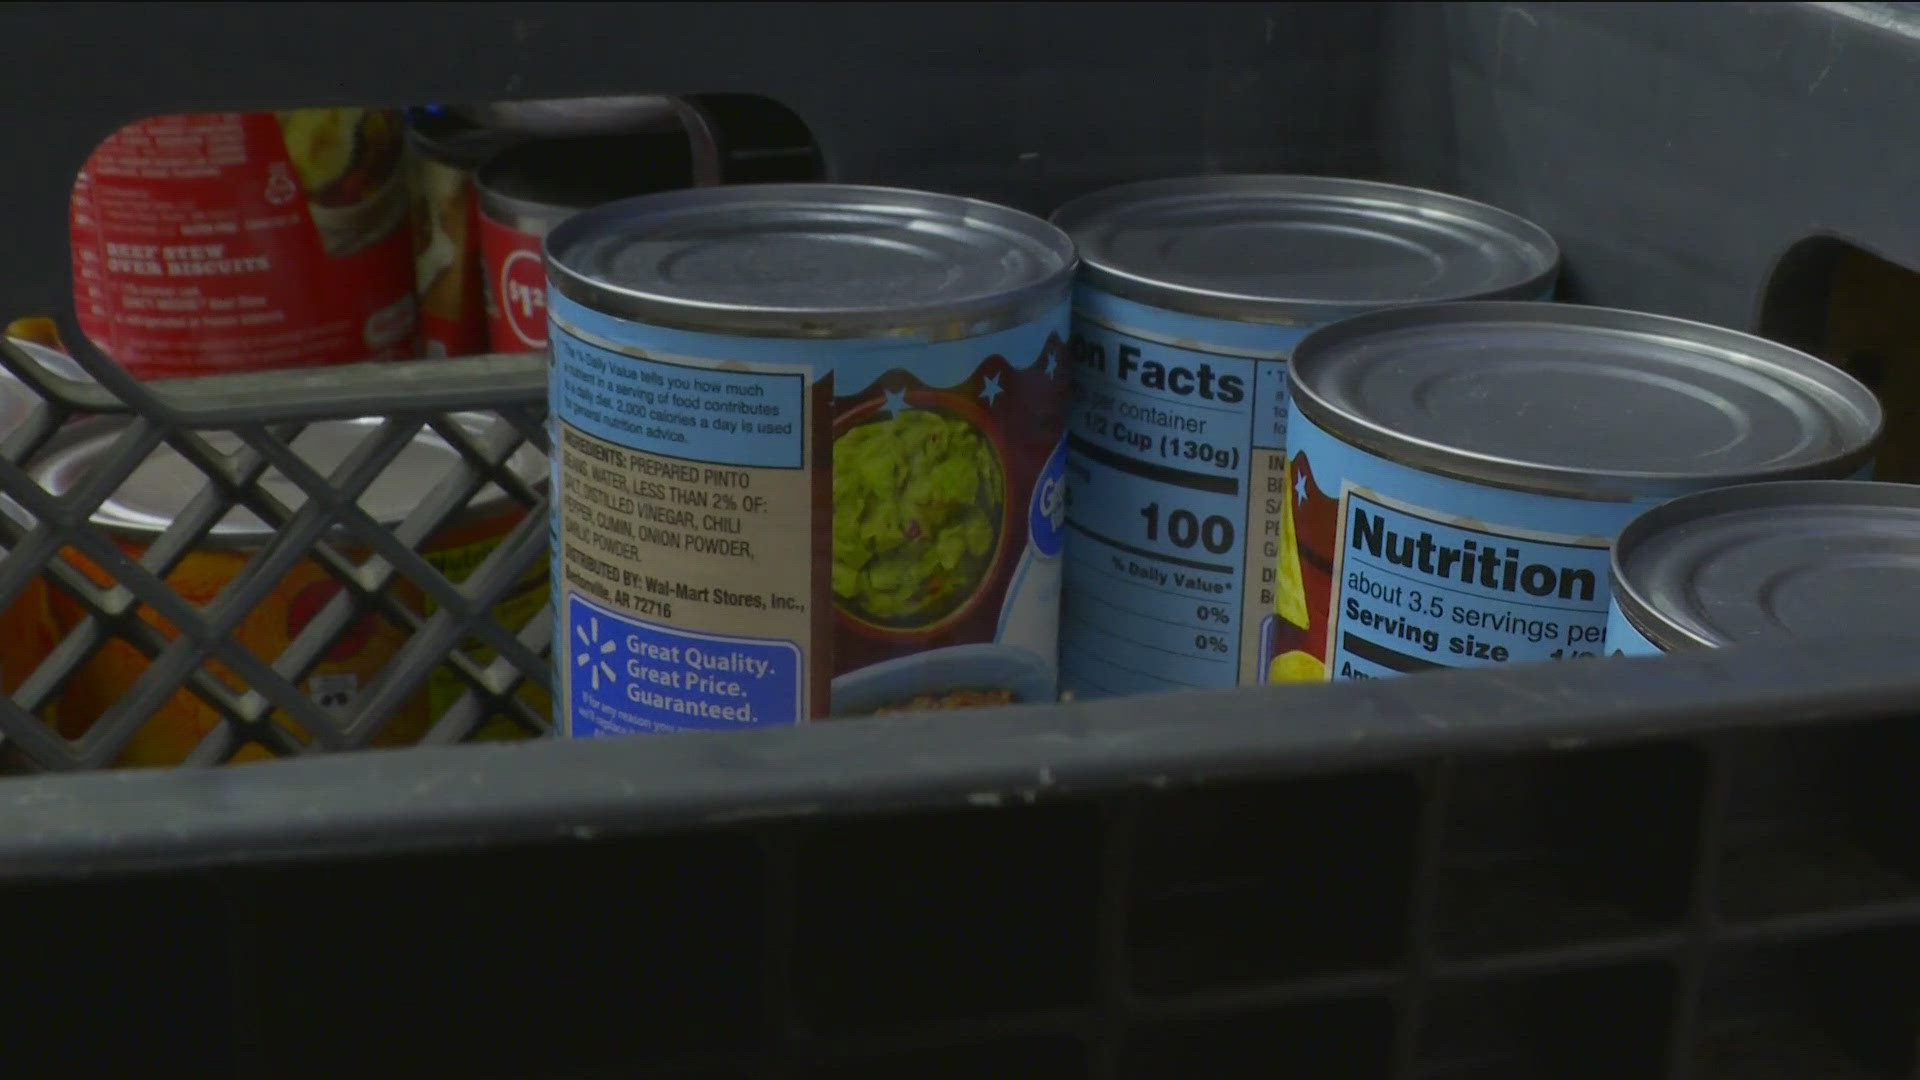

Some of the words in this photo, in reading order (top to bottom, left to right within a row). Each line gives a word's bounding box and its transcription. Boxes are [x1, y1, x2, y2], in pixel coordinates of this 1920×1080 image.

[608, 360, 637, 380] Value
[640, 369, 664, 387] tells
[668, 376, 690, 391] you
[694, 376, 721, 392] how
[725, 380, 764, 397] much
[1117, 344, 1245, 404] Facts
[615, 384, 654, 404] serving
[657, 392, 669, 405] of
[672, 392, 700, 410] food
[704, 398, 780, 416] contributes
[1120, 402, 1207, 434] container
[603, 415, 643, 434] nutrition
[649, 410, 697, 428] calories
[700, 419, 709, 428] a
[713, 419, 737, 435] day
[741, 421, 752, 434] is
[757, 421, 792, 435] used
[1113, 422, 1153, 452] Cup
[1160, 434, 1240, 470] (130g)
[592, 466, 630, 491] WATER,
[633, 481, 665, 500] LESS
[670, 487, 708, 509] THAN
[712, 493, 737, 511] 2%
[742, 495, 768, 513] OF:
[630, 455, 699, 484] PREPARED
[704, 469, 749, 488] PINTO
[583, 484, 634, 515] DISTILLED
[637, 503, 698, 531] VINEGAR,
[703, 514, 742, 534] CHILI
[1140, 501, 1235, 555] 100
[592, 532, 641, 562] POWDER.
[597, 512, 636, 539] CUMIN,
[639, 527, 680, 548] ONION
[685, 535, 754, 560] POWDER,
[1351, 507, 1596, 601] Nutrition
[623, 570, 643, 589] BY:
[646, 576, 709, 603] Wal-Mart
[713, 589, 767, 610] Stores,
[771, 593, 805, 613] Inc.,
[1128, 560, 1168, 587] Daily
[615, 590, 630, 608] AR
[634, 596, 671, 618] 72716
[1196, 605, 1230, 624] 0%
[1348, 570, 1402, 607] about
[1409, 591, 1443, 618] 3.5
[1452, 605, 1559, 645] servings
[1568, 623, 1607, 646] per
[1194, 635, 1228, 653] 0%
[1346, 598, 1440, 651] Serving
[1449, 633, 1510, 662] size
[626, 633, 680, 664] Great
[685, 647, 776, 679] Quality.
[626, 659, 680, 688] Great
[685, 672, 747, 698] Price.
[618, 711, 651, 729] reason
[626, 683, 758, 723] Guaranteed.
